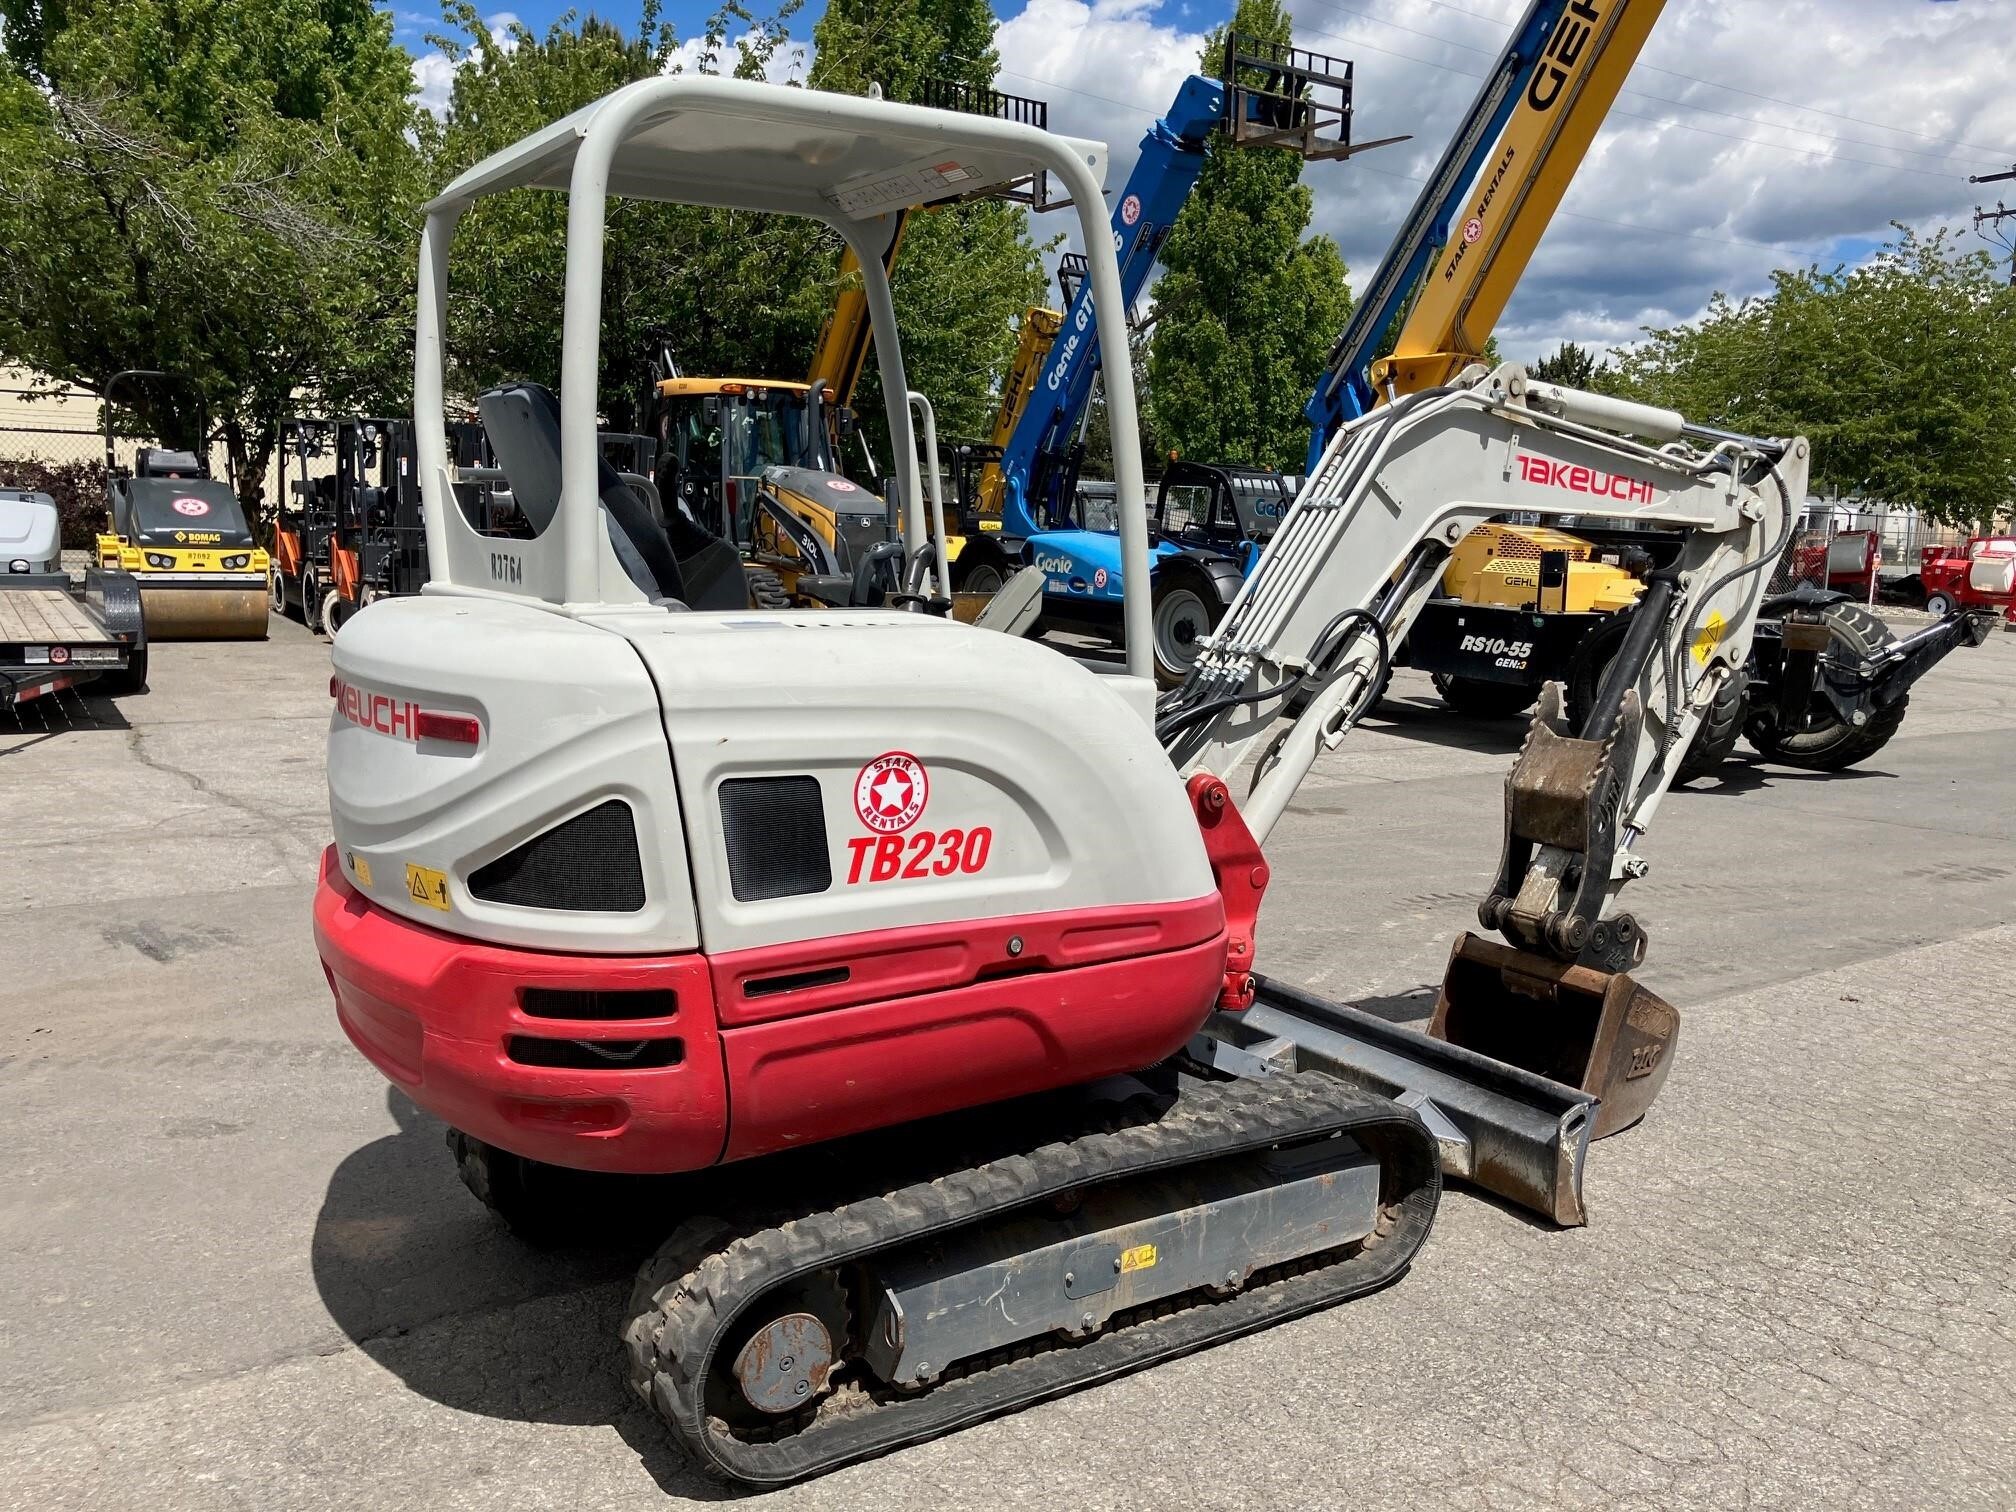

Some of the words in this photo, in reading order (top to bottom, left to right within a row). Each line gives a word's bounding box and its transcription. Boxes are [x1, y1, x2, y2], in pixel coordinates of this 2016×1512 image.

[1445, 239, 1468, 282] STAR
[1477, 145, 1515, 219] RENTALS
[1048, 334, 1079, 390] Genie
[1515, 455, 1654, 504] TAKEUCHI
[188, 533, 221, 542] BOMAG
[801, 534, 818, 559] 310L
[491, 553, 522, 584] R3764
[1035, 552, 1072, 574] Genie
[1505, 576, 1537, 588] GEHL
[1460, 635, 1533, 658] RS10-55
[1495, 658, 1527, 670] GEN:3
[873, 757, 912, 773] STAR
[862, 801, 919, 830] RENTALS
[847, 826, 992, 885] TB230
